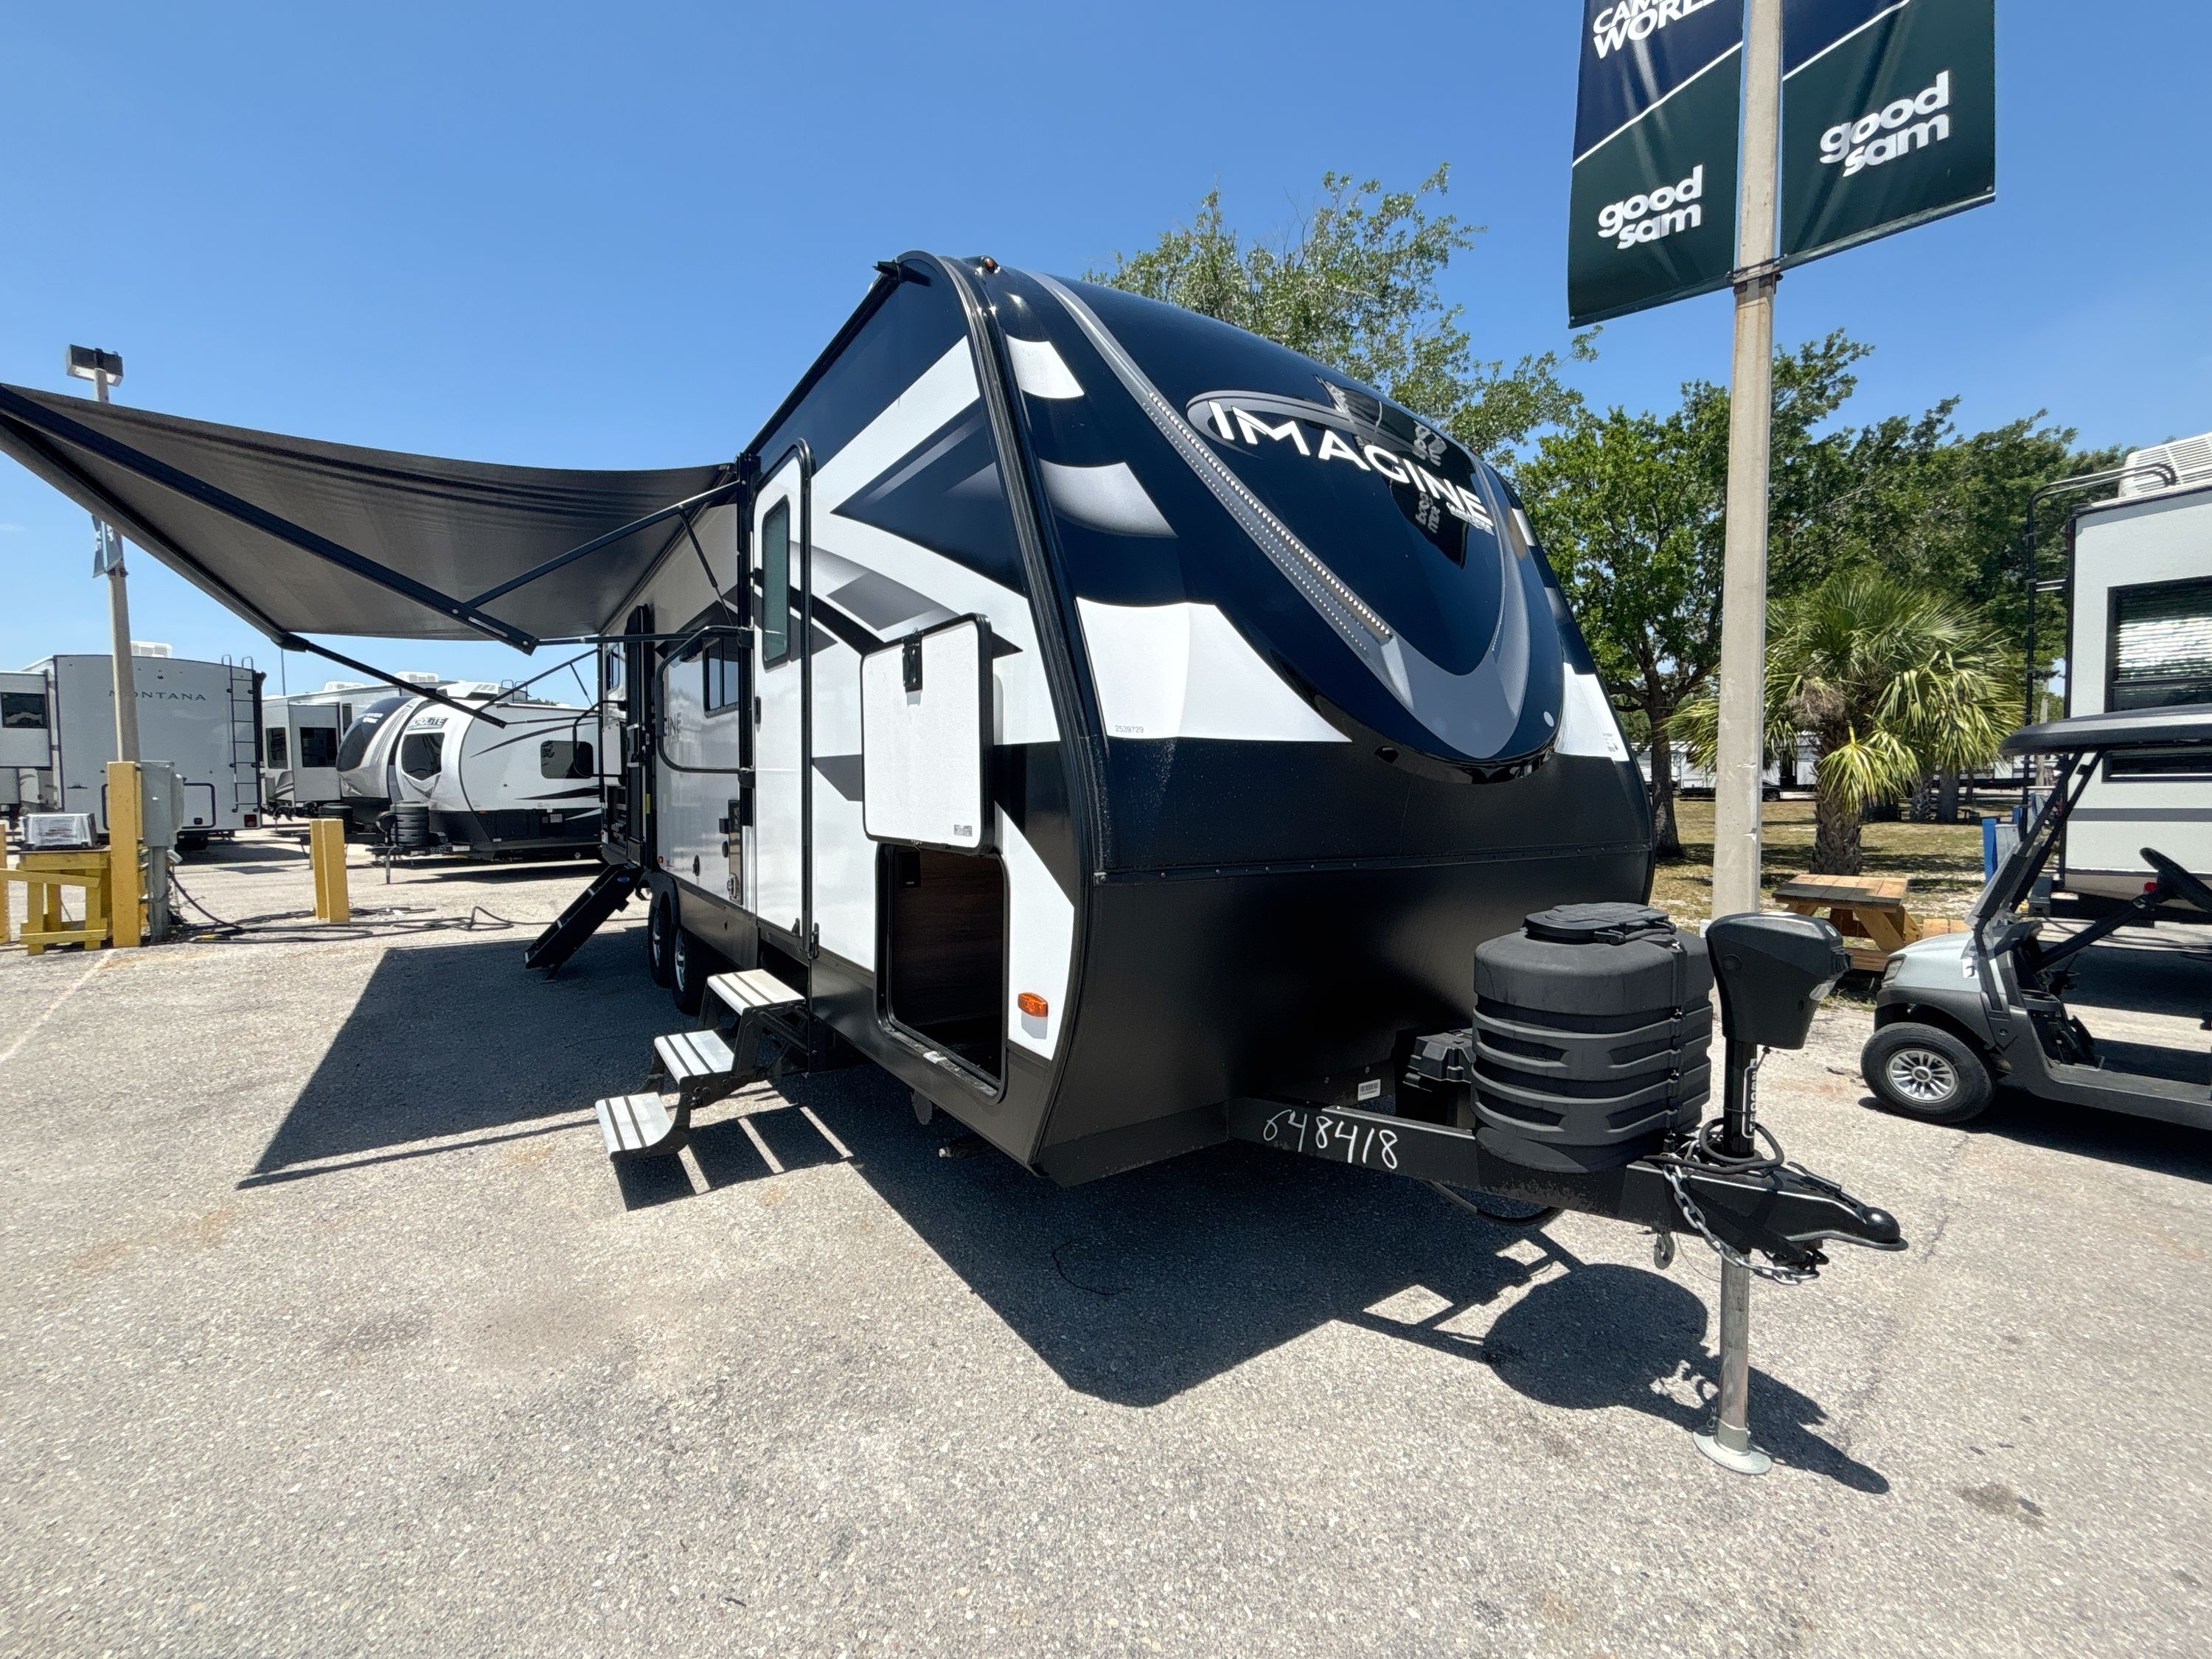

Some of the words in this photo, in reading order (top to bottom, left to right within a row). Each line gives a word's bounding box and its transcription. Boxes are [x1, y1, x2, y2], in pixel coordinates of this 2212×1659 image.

[1593, 0, 1718, 59] WORL
[1819, 70, 1950, 164] good
[1843, 114, 1950, 177] sam
[1597, 164, 1703, 238] good
[1616, 204, 1702, 249] sam
[1207, 400, 1494, 527] IMAGINE
[108, 690, 207, 701] NTANA
[1115, 724, 1144, 734] 2539729
[1263, 1109, 1399, 1169] 648418
